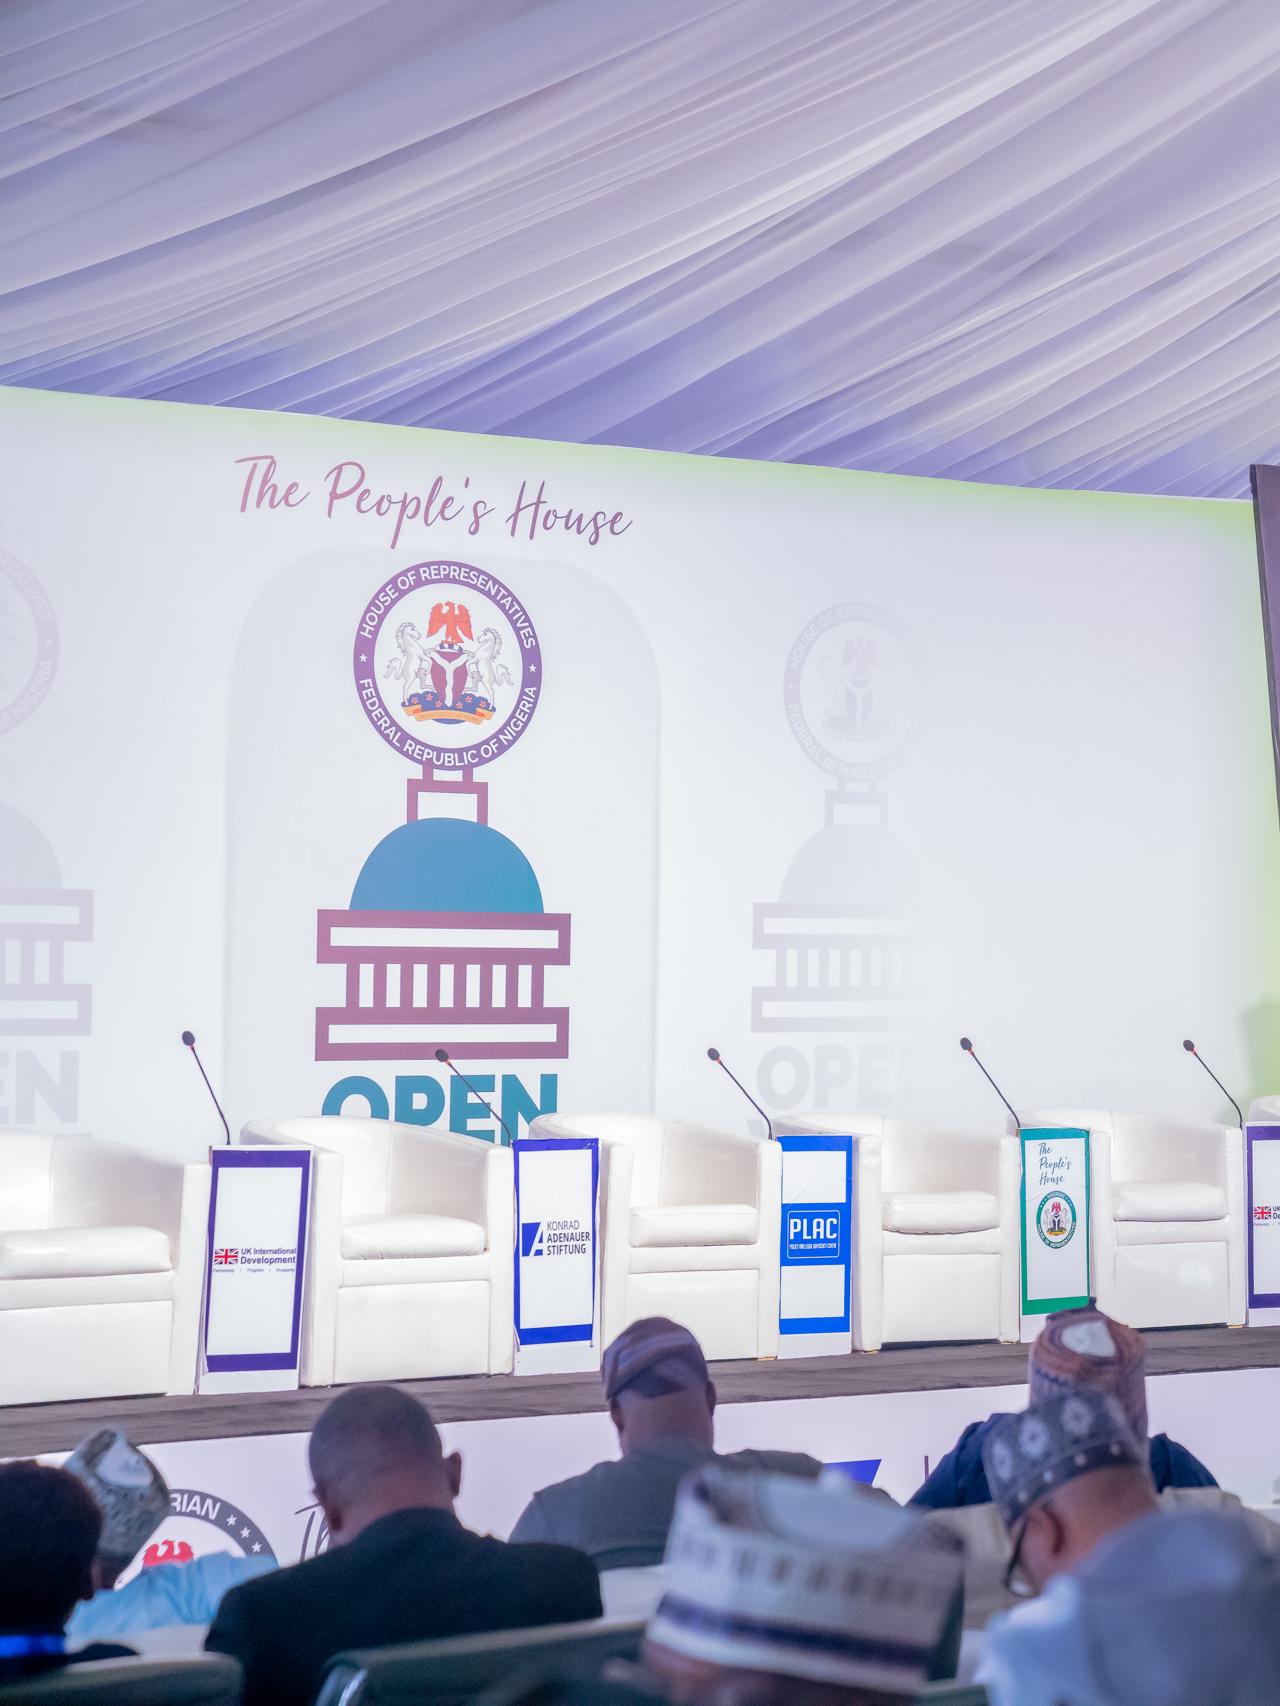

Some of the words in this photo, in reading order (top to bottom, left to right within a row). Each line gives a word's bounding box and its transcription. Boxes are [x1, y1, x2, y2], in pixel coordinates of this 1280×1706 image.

[235, 455, 310, 513] The
[323, 461, 496, 549] People's
[505, 480, 633, 546] House
[360, 585, 399, 638] HOUSE
[397, 571, 418, 590] OF
[420, 565, 536, 649] REPRESENTATIVES
[360, 678, 400, 746] FEDERAL
[403, 739, 479, 766] REPUBLIC
[480, 738, 500, 758] OF
[498, 686, 536, 746] NIGERIA
[1038, 1142, 1052, 1156] The
[1039, 1156, 1071, 1175] People's
[1039, 1171, 1064, 1186] House
[547, 1220, 580, 1231] KONRAD
[790, 1218, 837, 1240] PLAC
[547, 1231, 591, 1243] ADENAUER
[253, 1247, 296, 1255] International
[547, 1244, 586, 1255] STIFTUNG
[240, 1256, 296, 1265] Development
